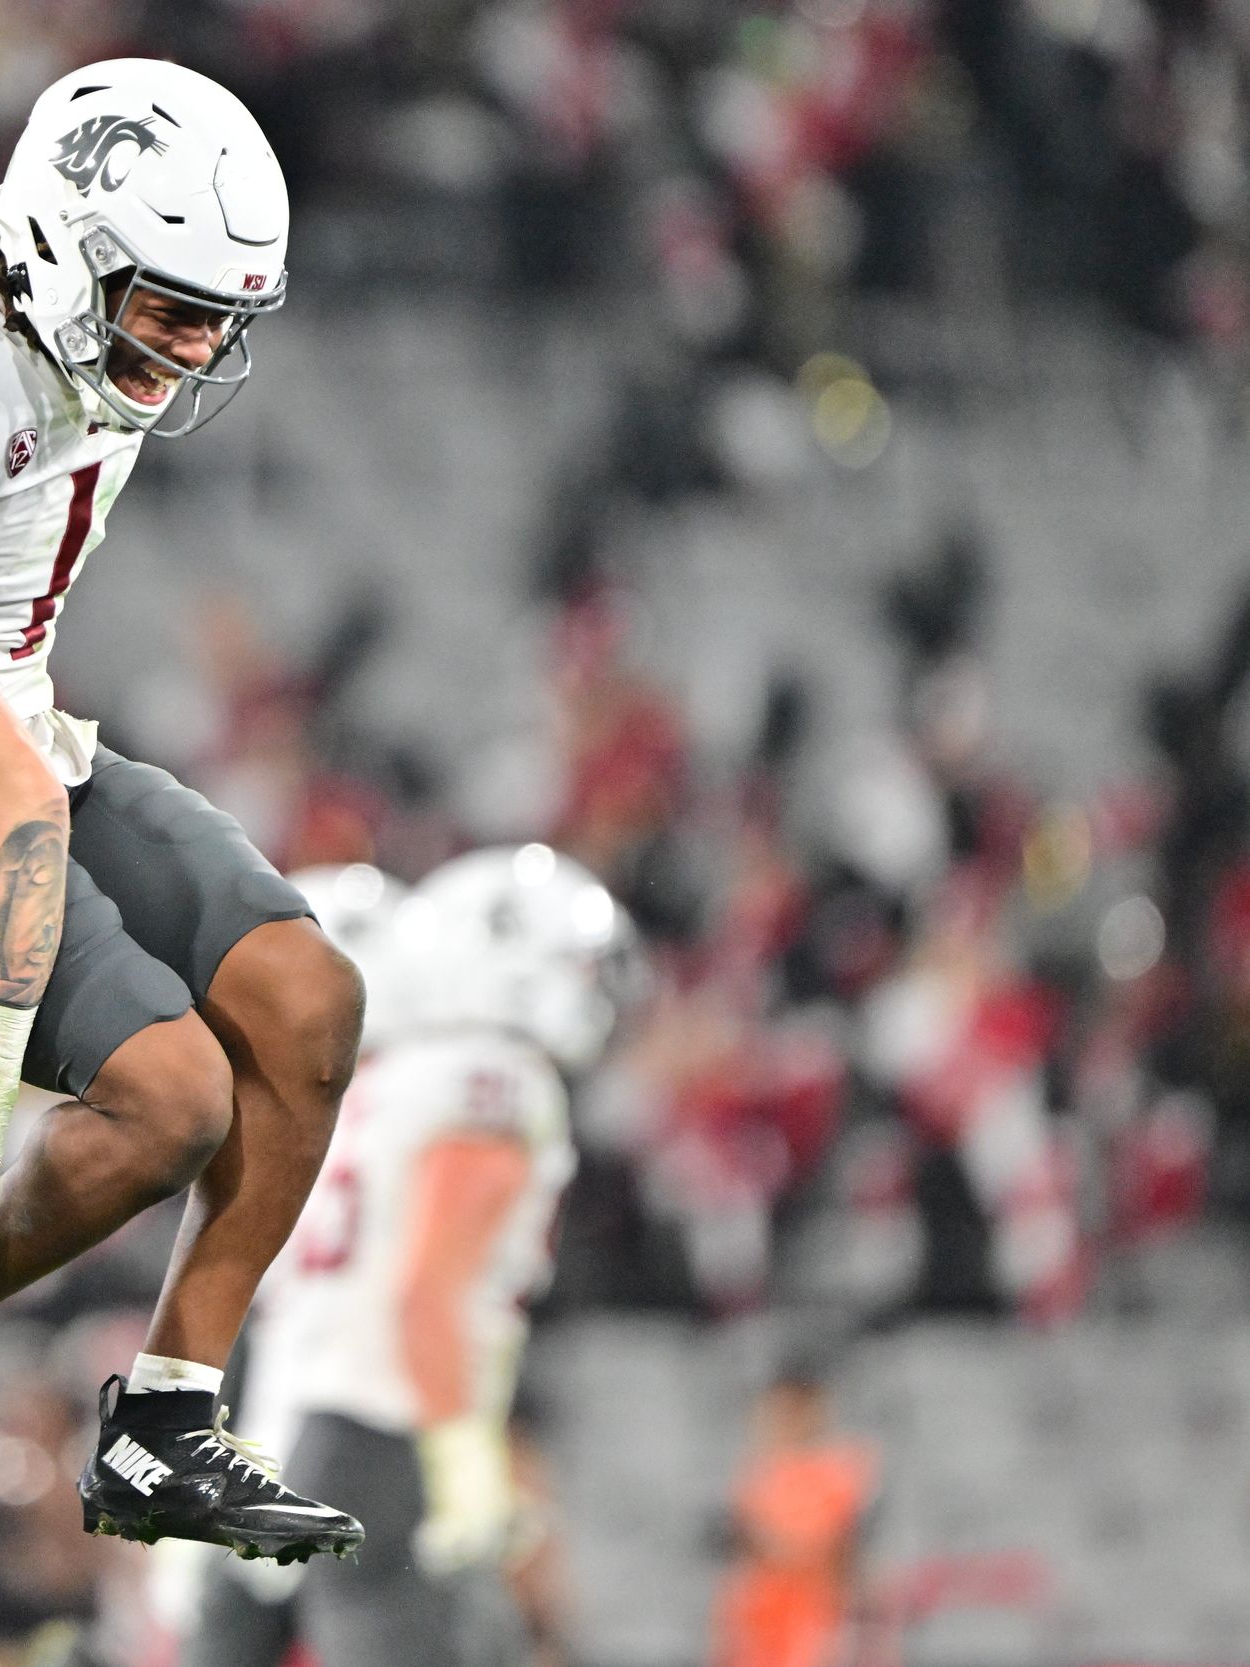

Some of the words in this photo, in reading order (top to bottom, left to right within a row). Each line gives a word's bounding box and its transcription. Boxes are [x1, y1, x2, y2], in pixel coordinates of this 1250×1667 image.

[242, 273, 267, 291] WSU
[11, 449, 28, 470] 12
[10, 460, 102, 661] 1
[102, 1434, 174, 1496] NIKE
